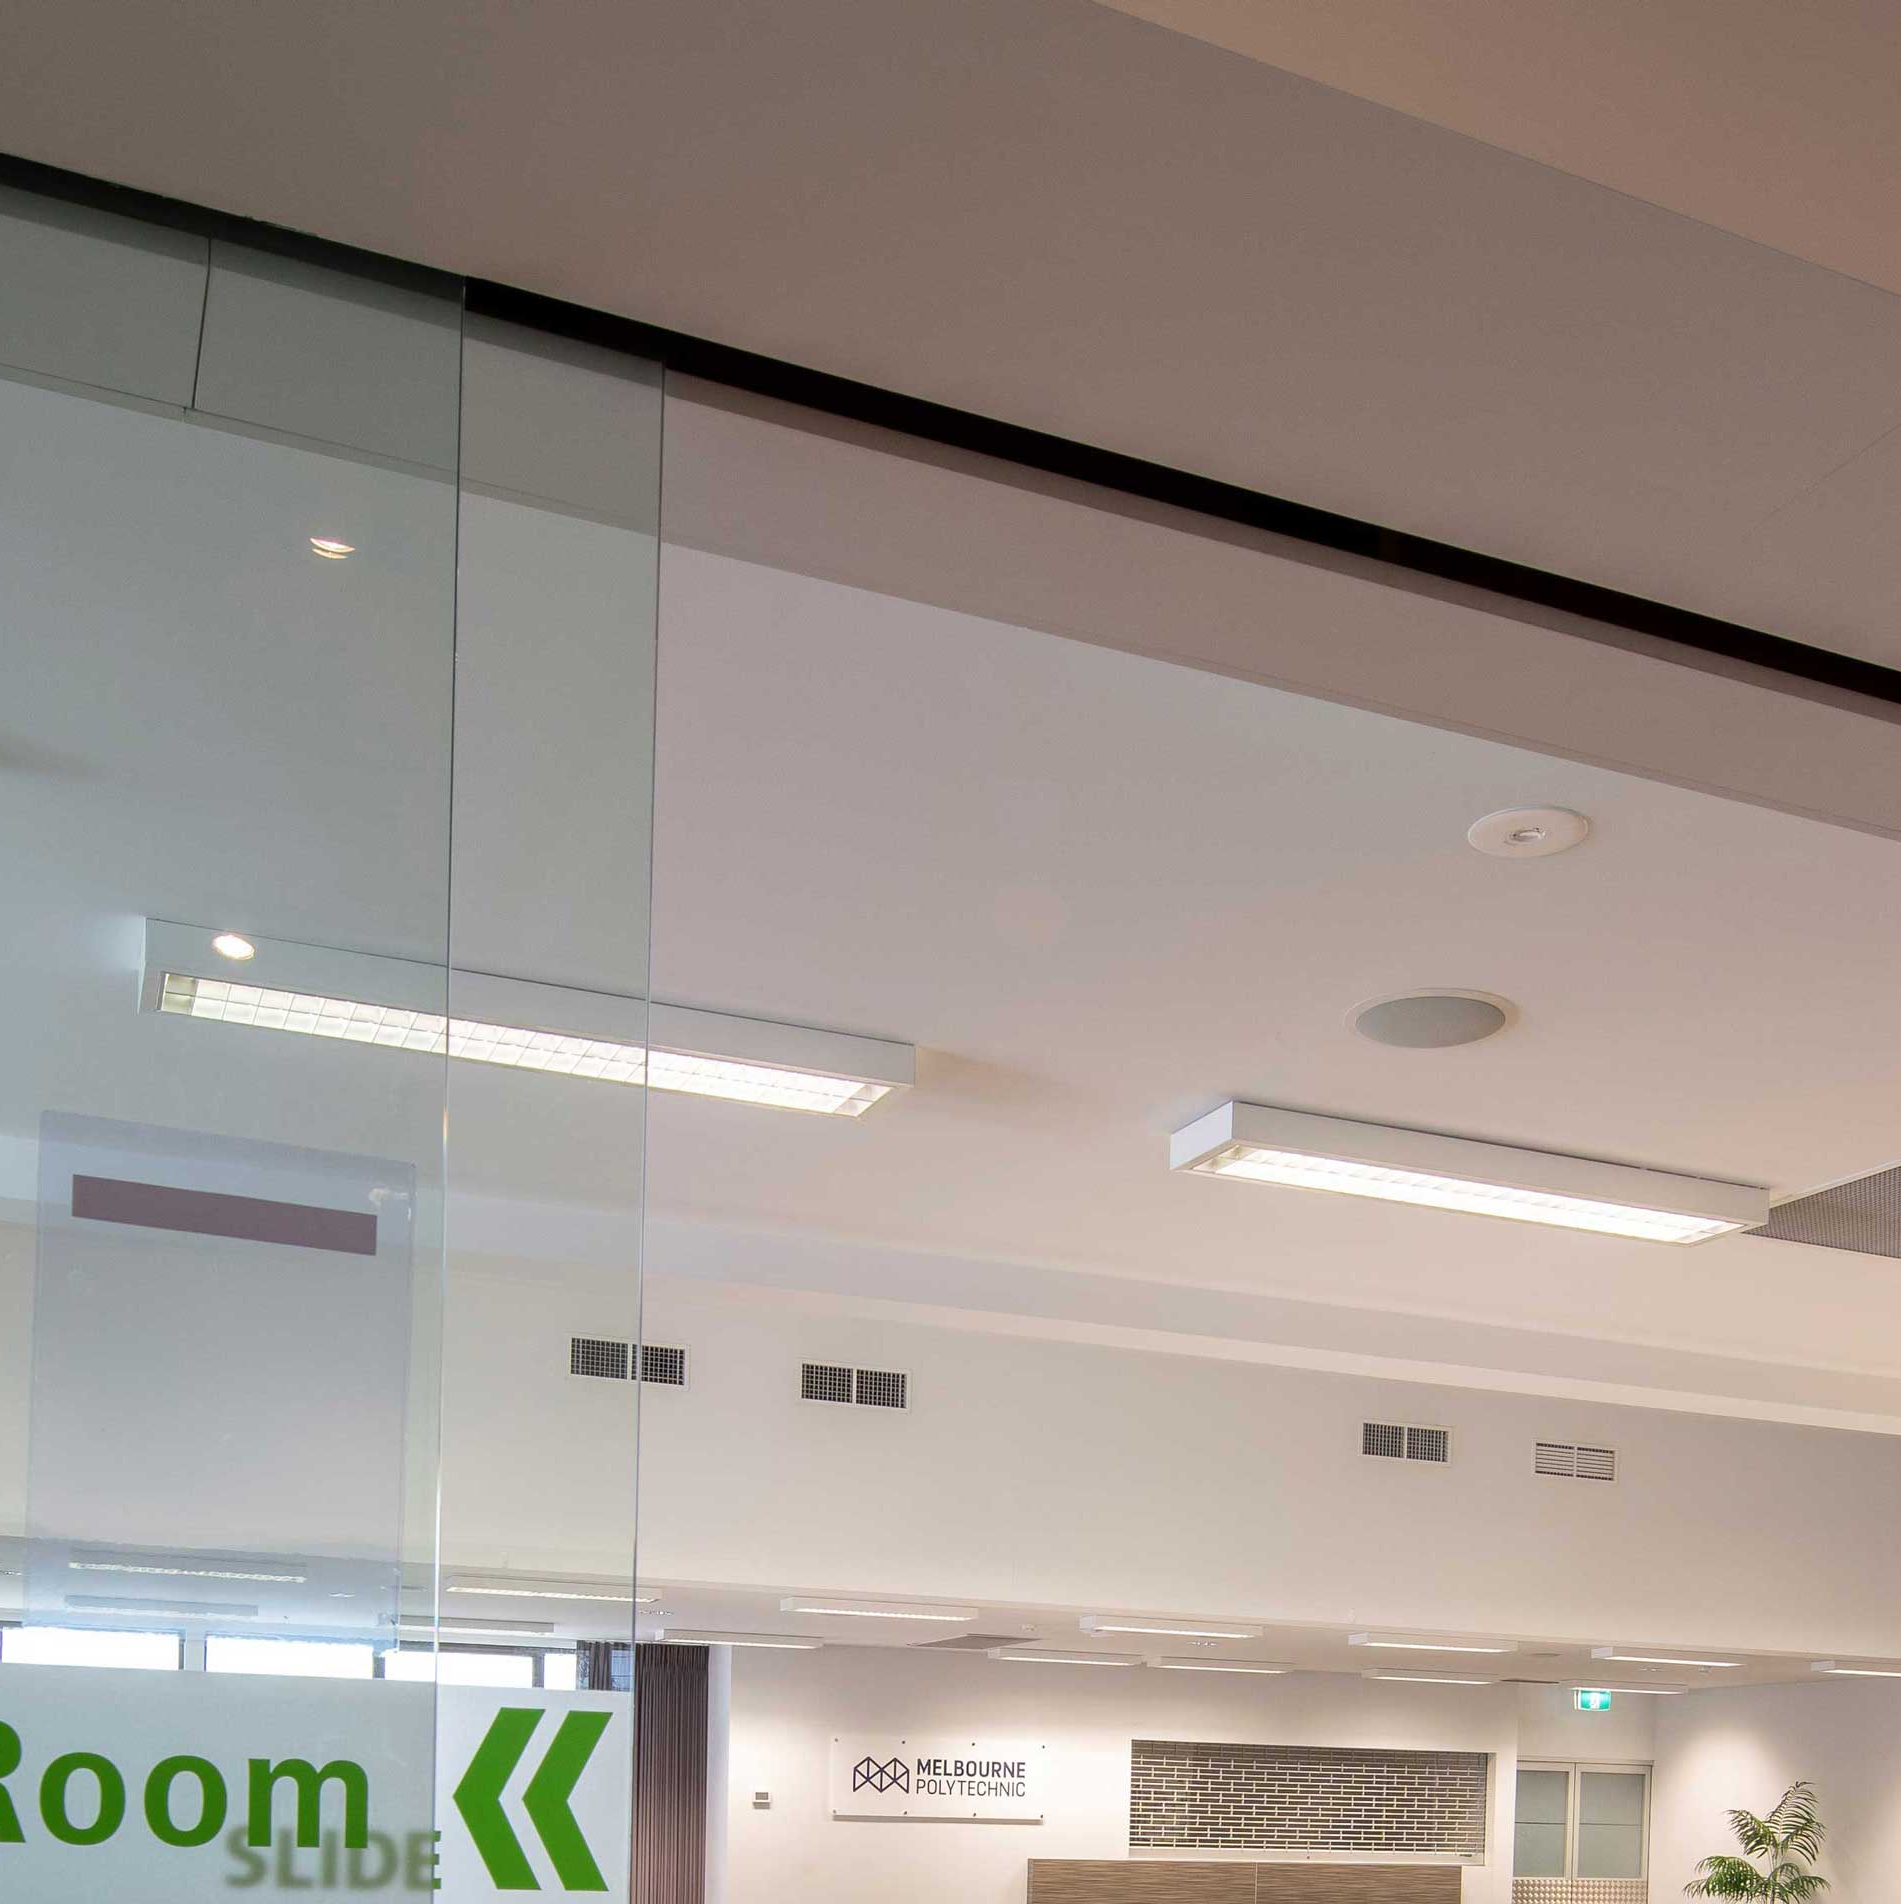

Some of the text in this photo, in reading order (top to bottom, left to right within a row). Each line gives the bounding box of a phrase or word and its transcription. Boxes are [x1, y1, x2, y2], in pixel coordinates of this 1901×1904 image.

[916, 1758, 1026, 1779] MELBOURNE
[916, 1778, 1026, 1797] POLYTECHNIC
[223, 1825, 442, 1892] SLIDE
